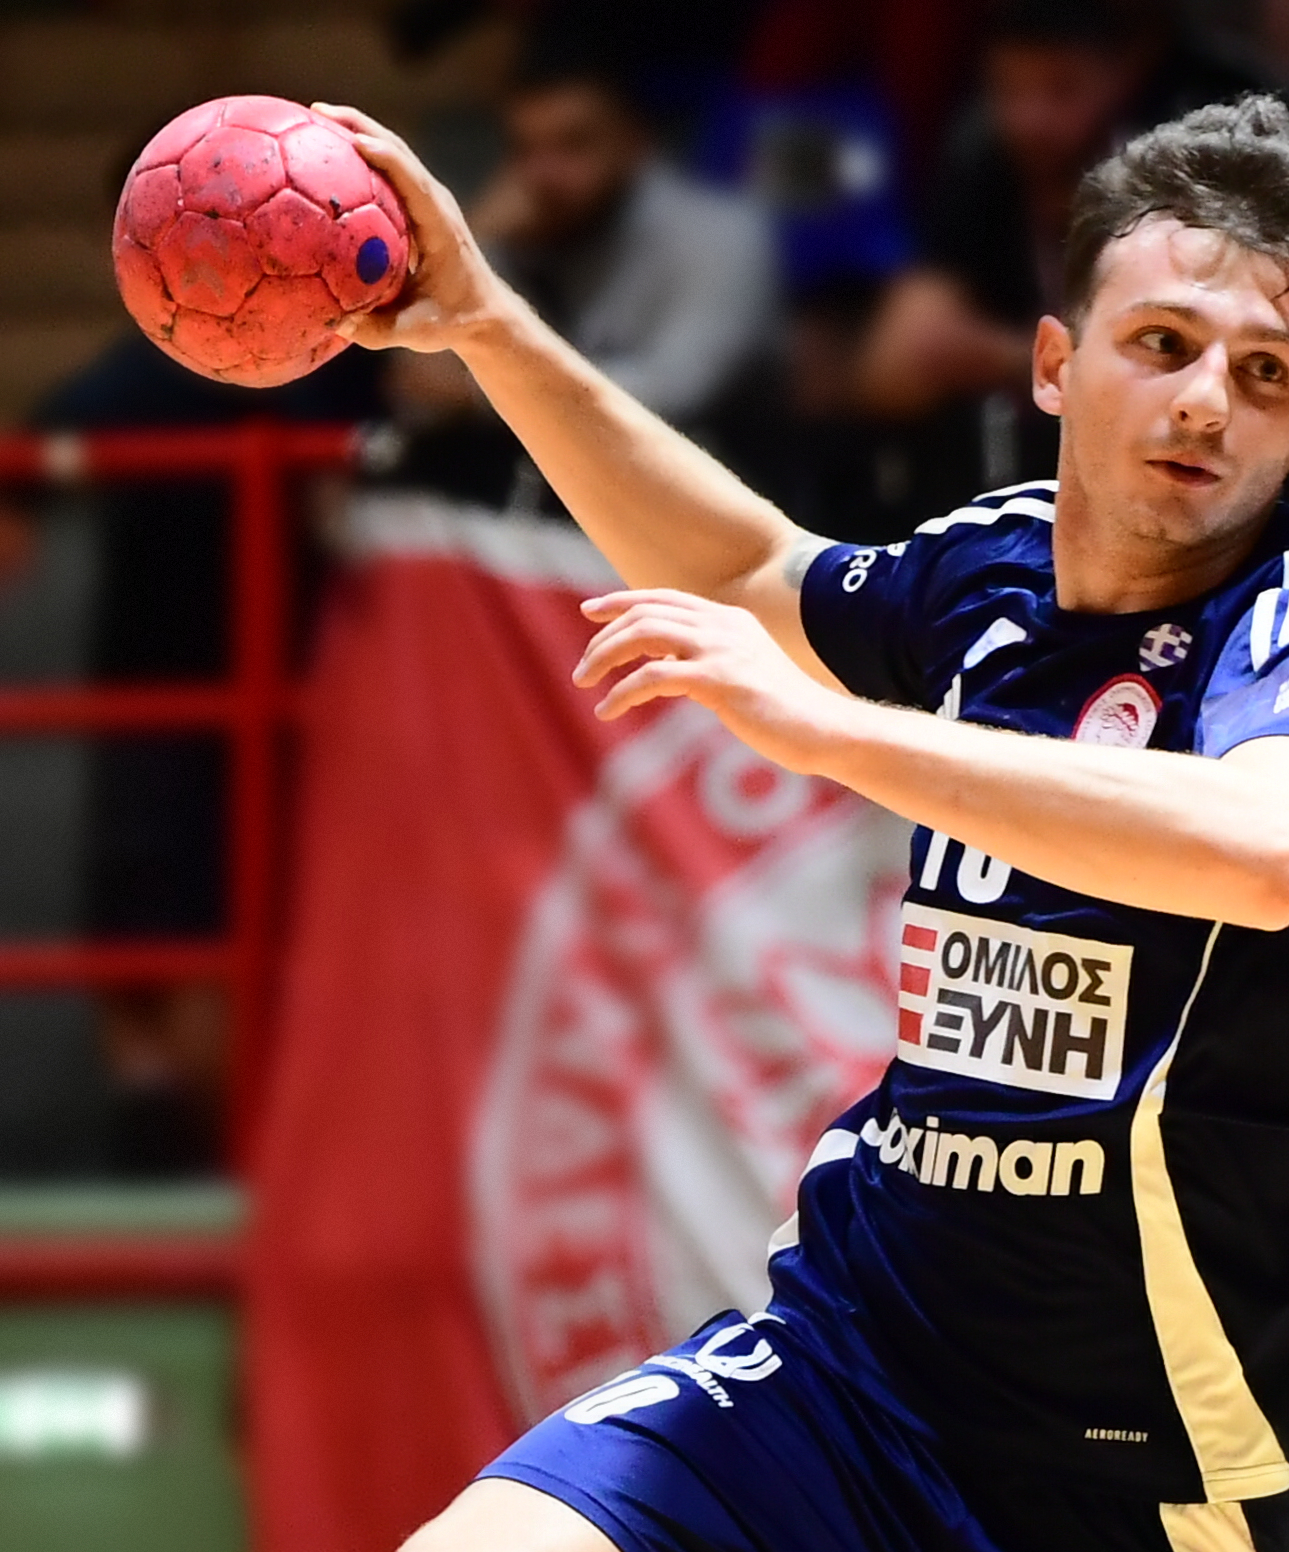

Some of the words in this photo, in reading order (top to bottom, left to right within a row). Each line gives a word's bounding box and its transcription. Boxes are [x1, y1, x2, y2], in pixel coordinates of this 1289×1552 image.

[941, 931, 1112, 1006] ΟΜΙΛΟΣ
[926, 988, 1108, 1080] ΞΥΝΗ
[1084, 1428, 1149, 1442] AEROREADY
